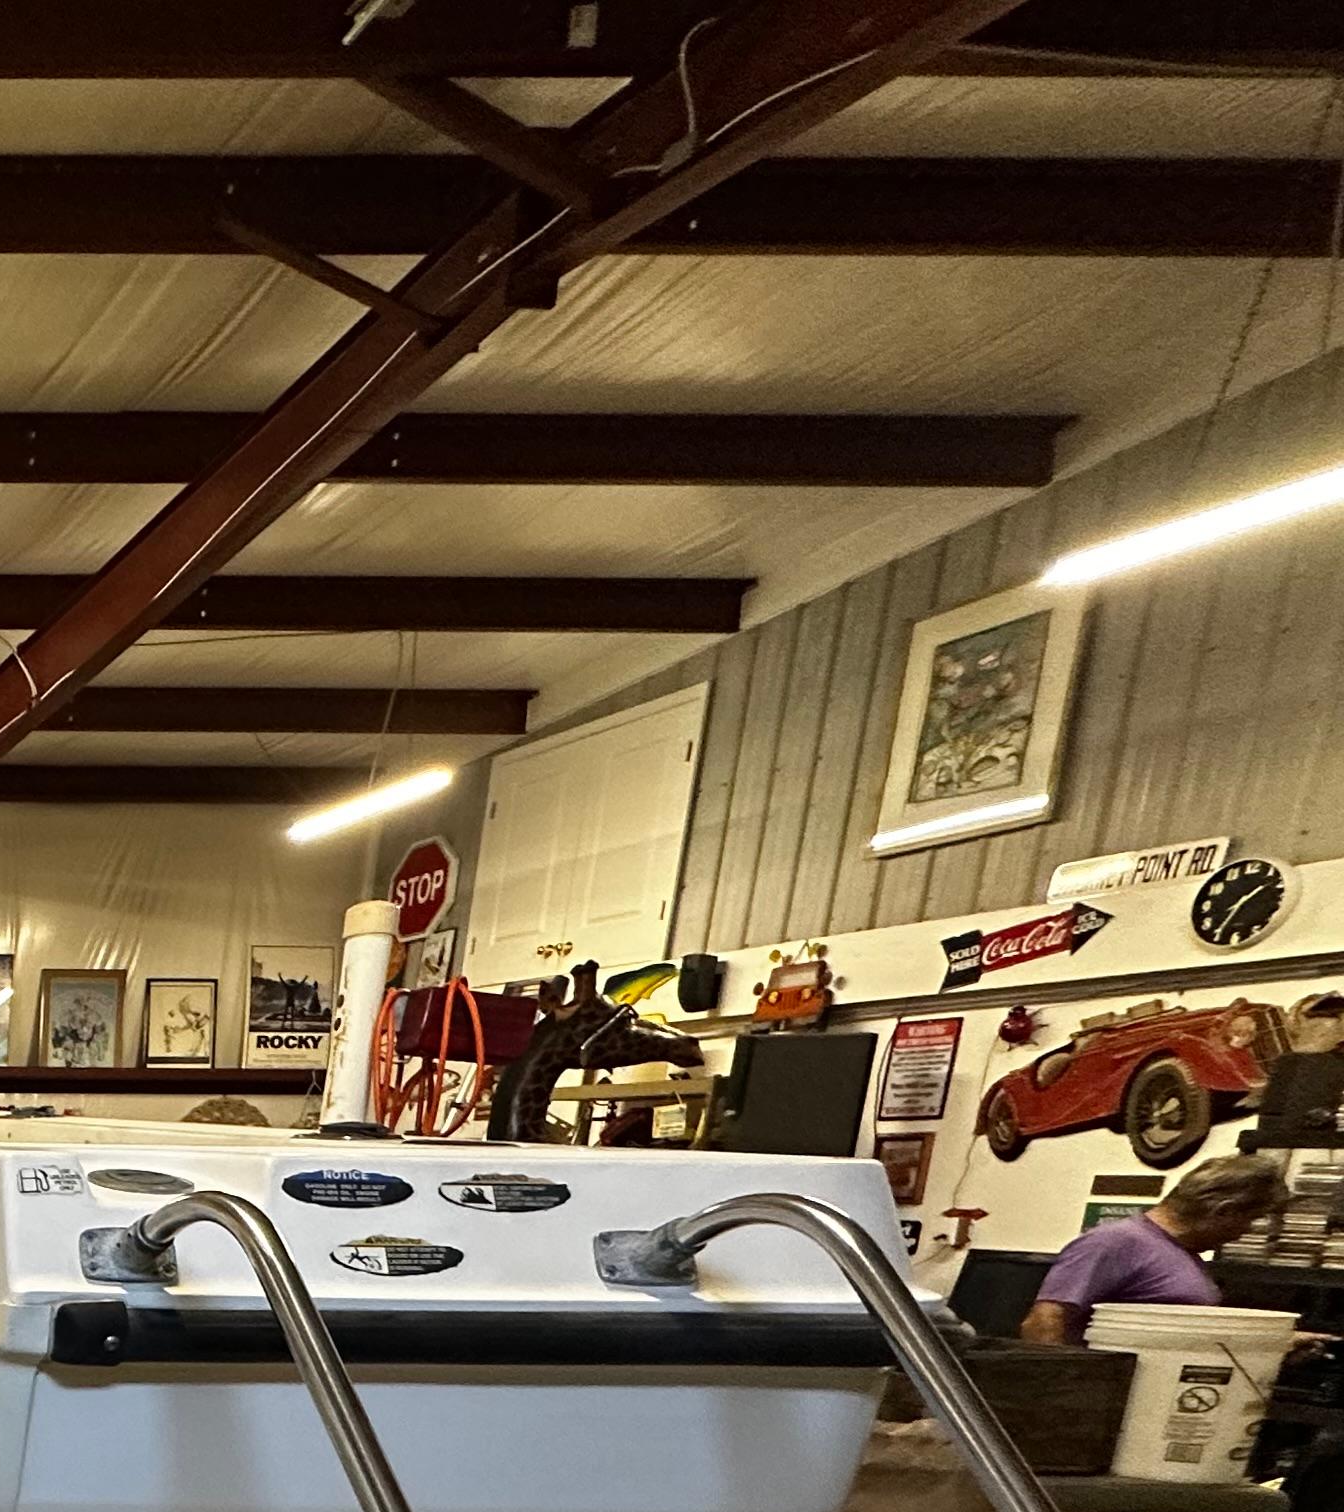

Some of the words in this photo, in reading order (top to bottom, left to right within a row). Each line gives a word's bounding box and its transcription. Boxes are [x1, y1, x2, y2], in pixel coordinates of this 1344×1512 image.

[1131, 852, 1184, 885] POINT
[395, 868, 446, 910] STOP
[949, 943, 981, 962] SOLD
[950, 958, 981, 975] HERE
[256, 1034, 323, 1049] ROCKY
[323, 1170, 370, 1180] NOTICE
